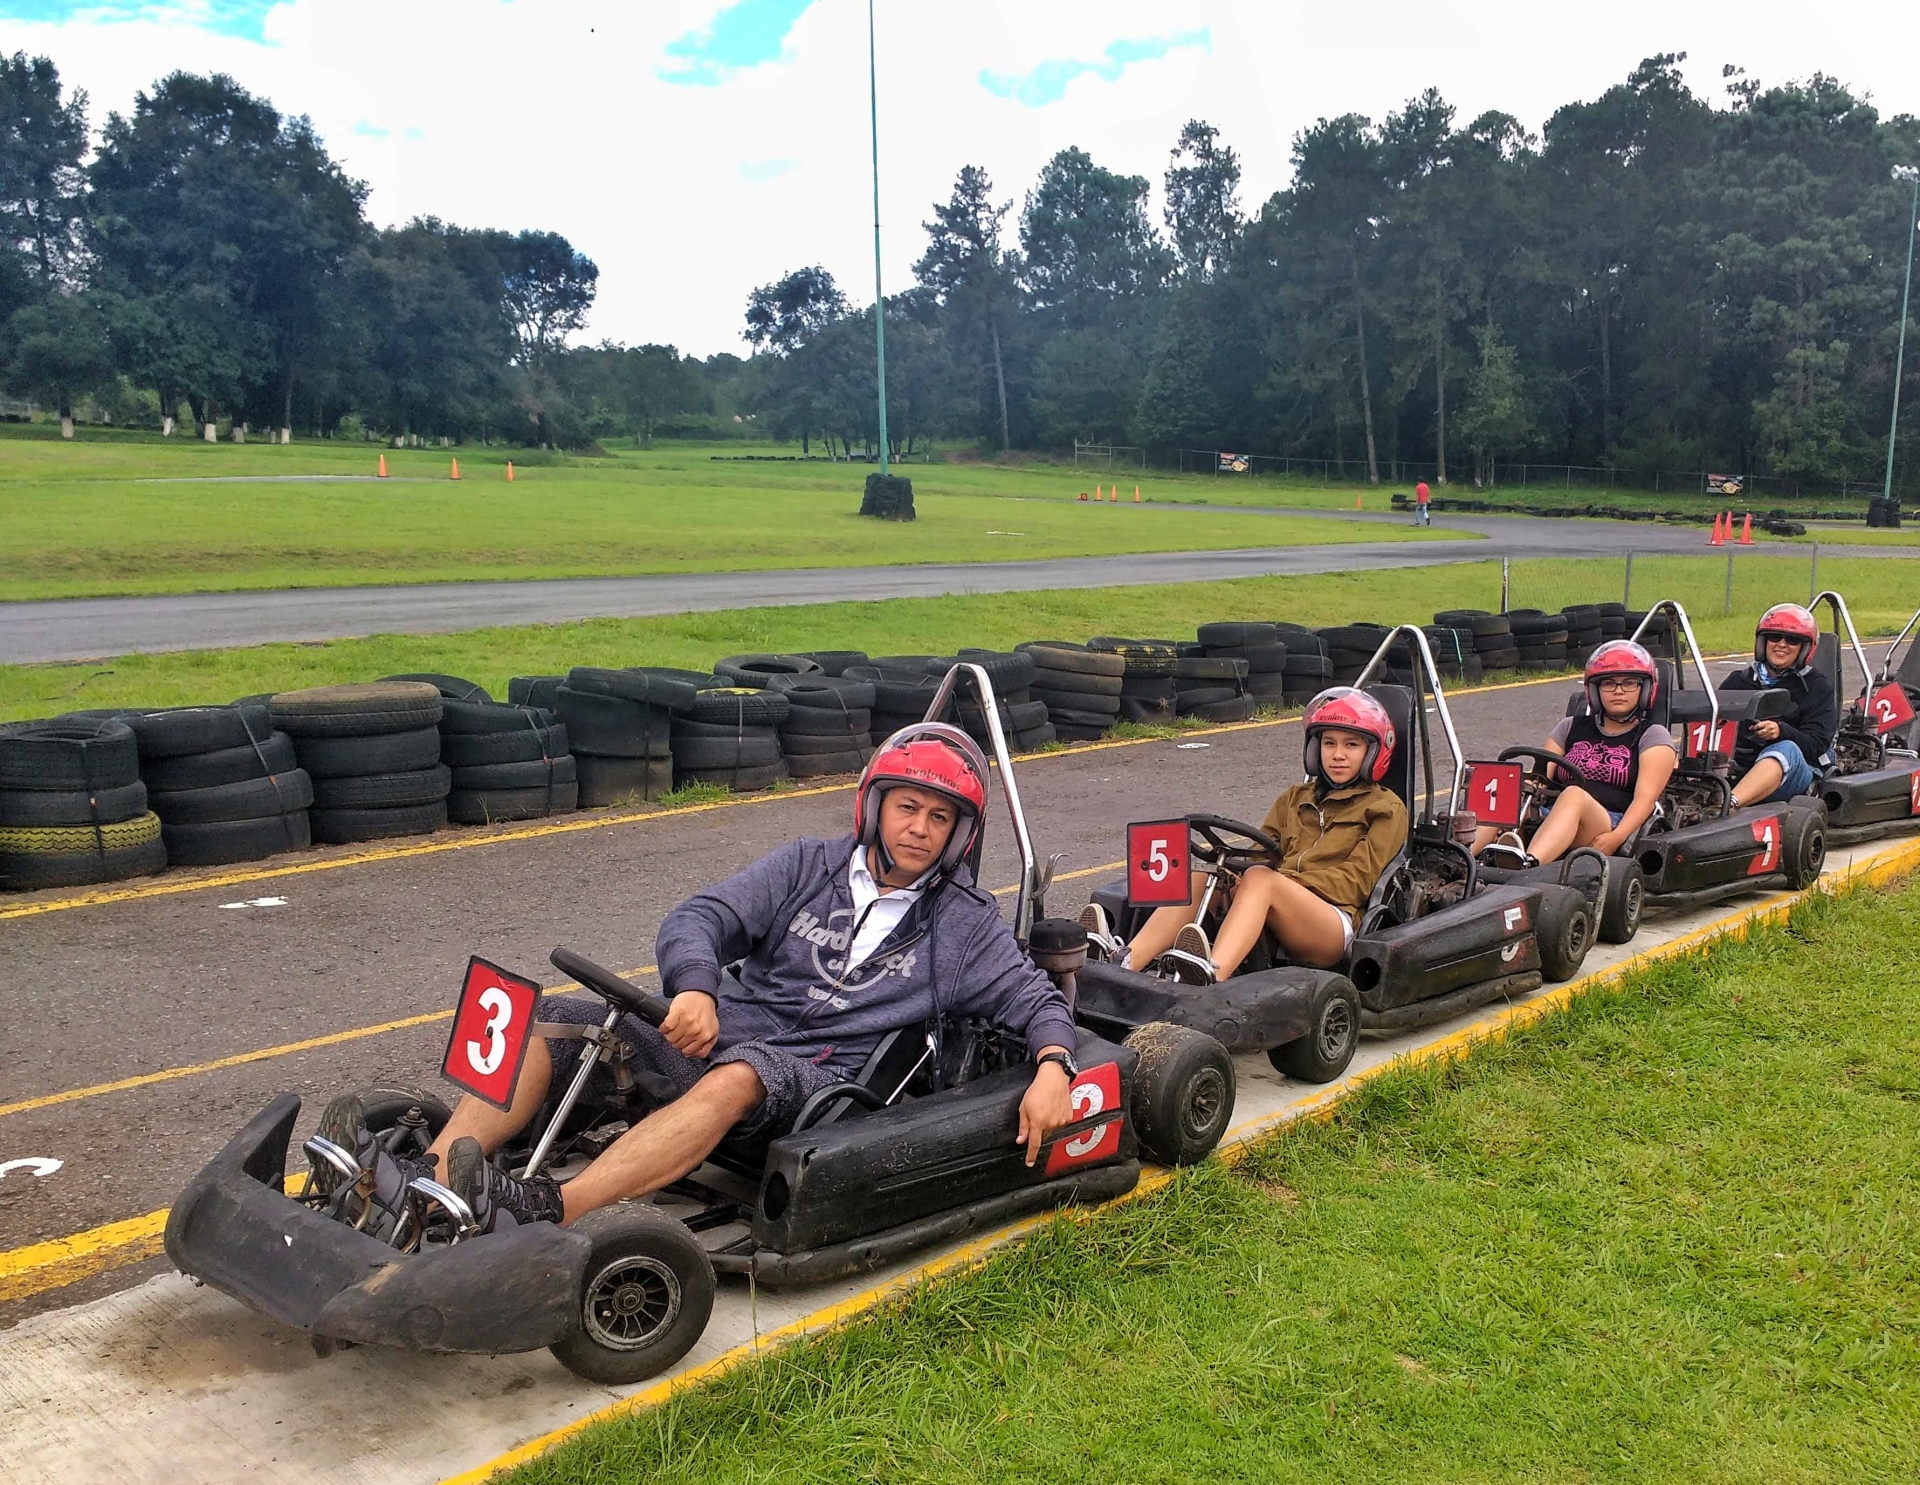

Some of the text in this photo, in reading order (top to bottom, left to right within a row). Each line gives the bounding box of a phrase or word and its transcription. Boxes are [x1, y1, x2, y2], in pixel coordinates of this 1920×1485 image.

[1875, 699, 1898, 723] 2
[905, 767, 960, 791] evolution
[1484, 778, 1498, 811] 1
[1149, 839, 1169, 882] 5
[1761, 825, 1773, 867] 1
[789, 910, 853, 953] Hard
[467, 987, 513, 1075] 3
[1065, 1082, 1107, 1157] 3
